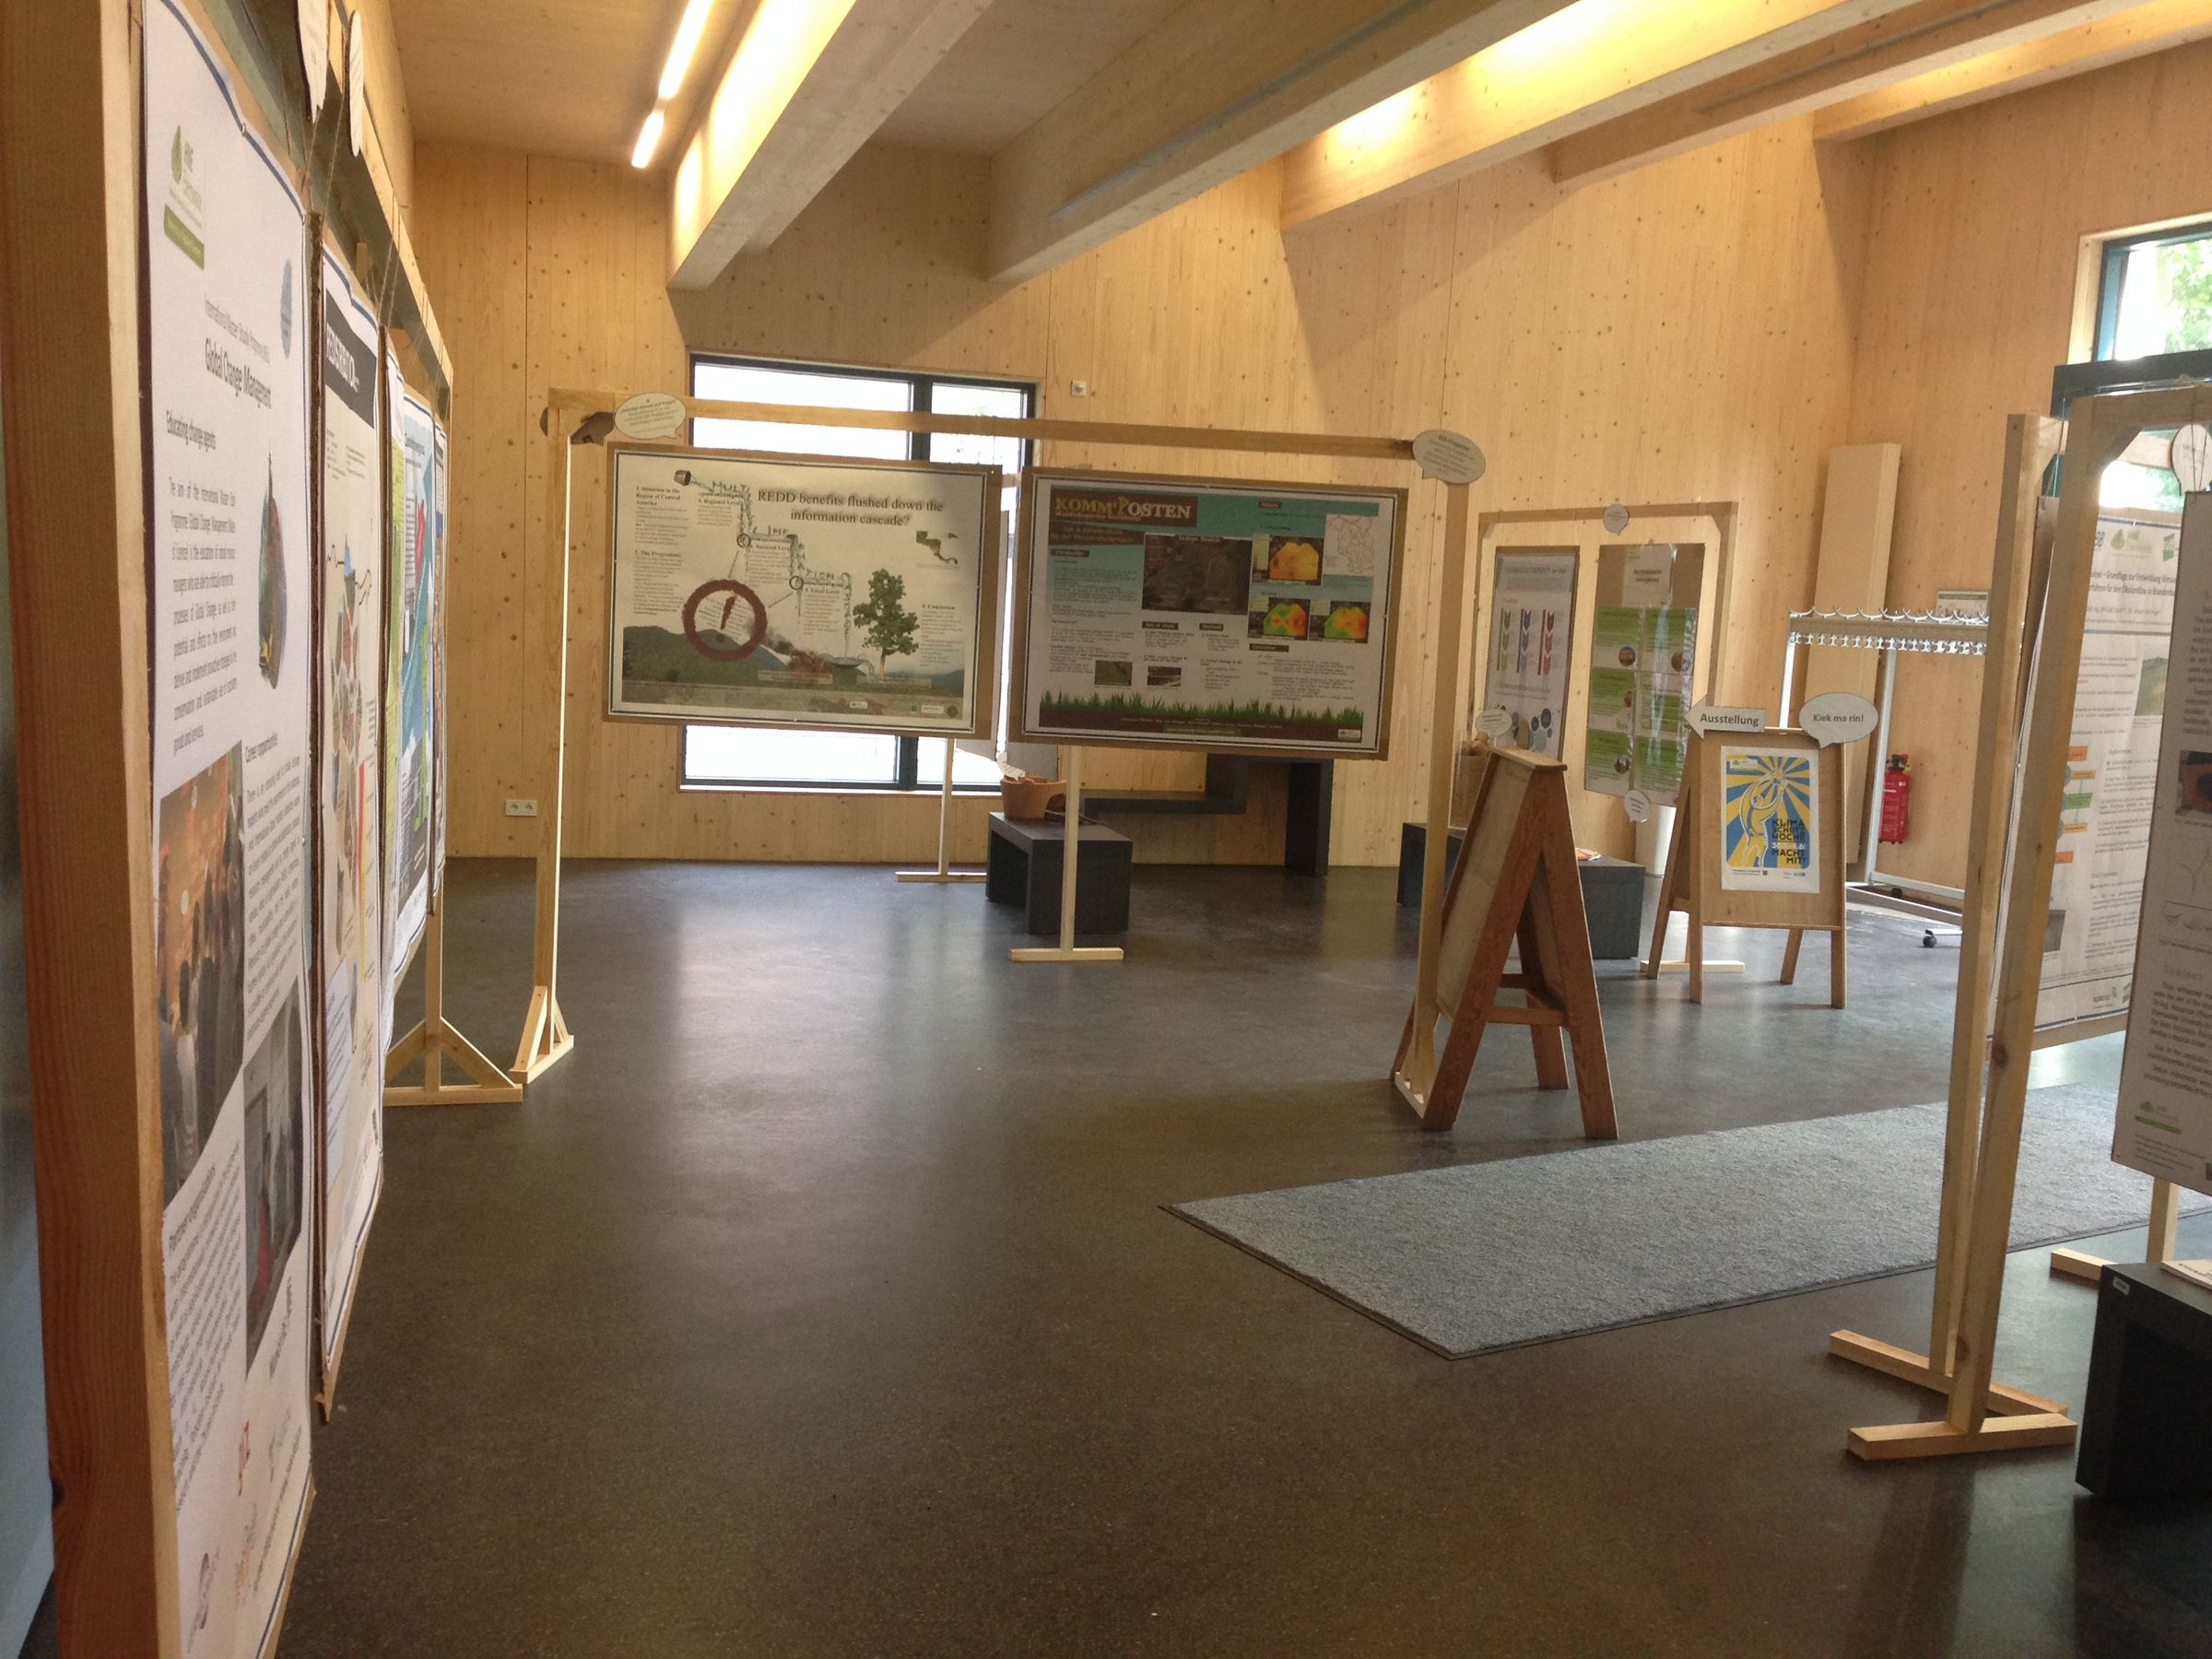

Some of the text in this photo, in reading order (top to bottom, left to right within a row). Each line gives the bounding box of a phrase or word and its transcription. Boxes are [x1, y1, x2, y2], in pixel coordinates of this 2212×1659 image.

[205, 337, 272, 409] Global Change Management
[758, 490, 944, 512] REDD benefits flushed down the
[790, 509, 910, 526] information cascade?
[1700, 713, 1759, 727] Ausstellung
[1813, 713, 1831, 723] Kiek
[1849, 713, 1865, 723] rin!
[1771, 818, 1805, 827] KLIMA
[1771, 849, 1806, 857] MACHT
